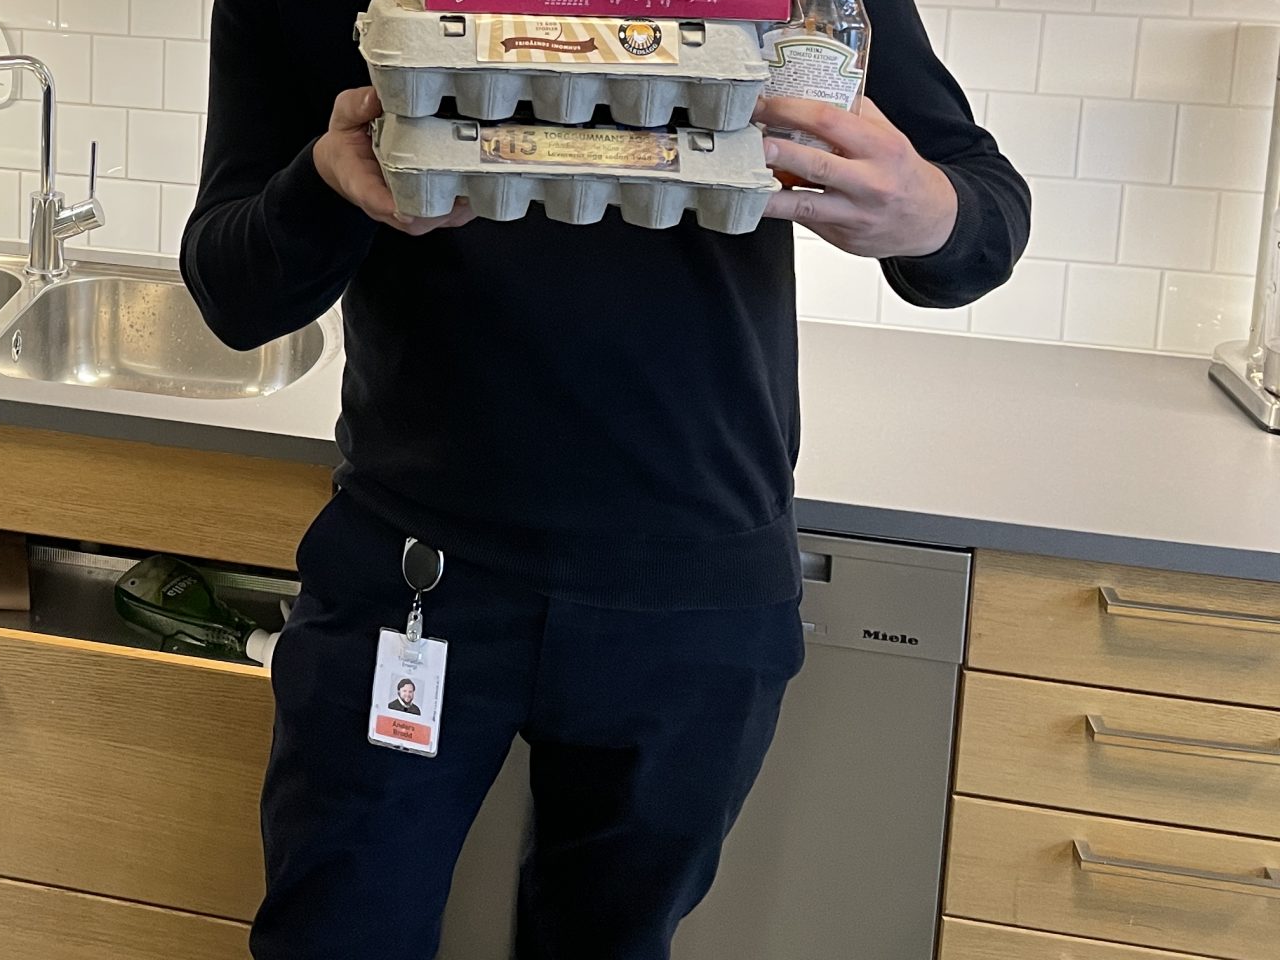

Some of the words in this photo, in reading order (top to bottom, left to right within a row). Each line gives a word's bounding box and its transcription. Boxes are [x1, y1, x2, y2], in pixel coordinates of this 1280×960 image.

[789, 50, 813, 59] TOMATO
[805, 46, 823, 54] HEINZ
[863, 629, 919, 645] Miele
